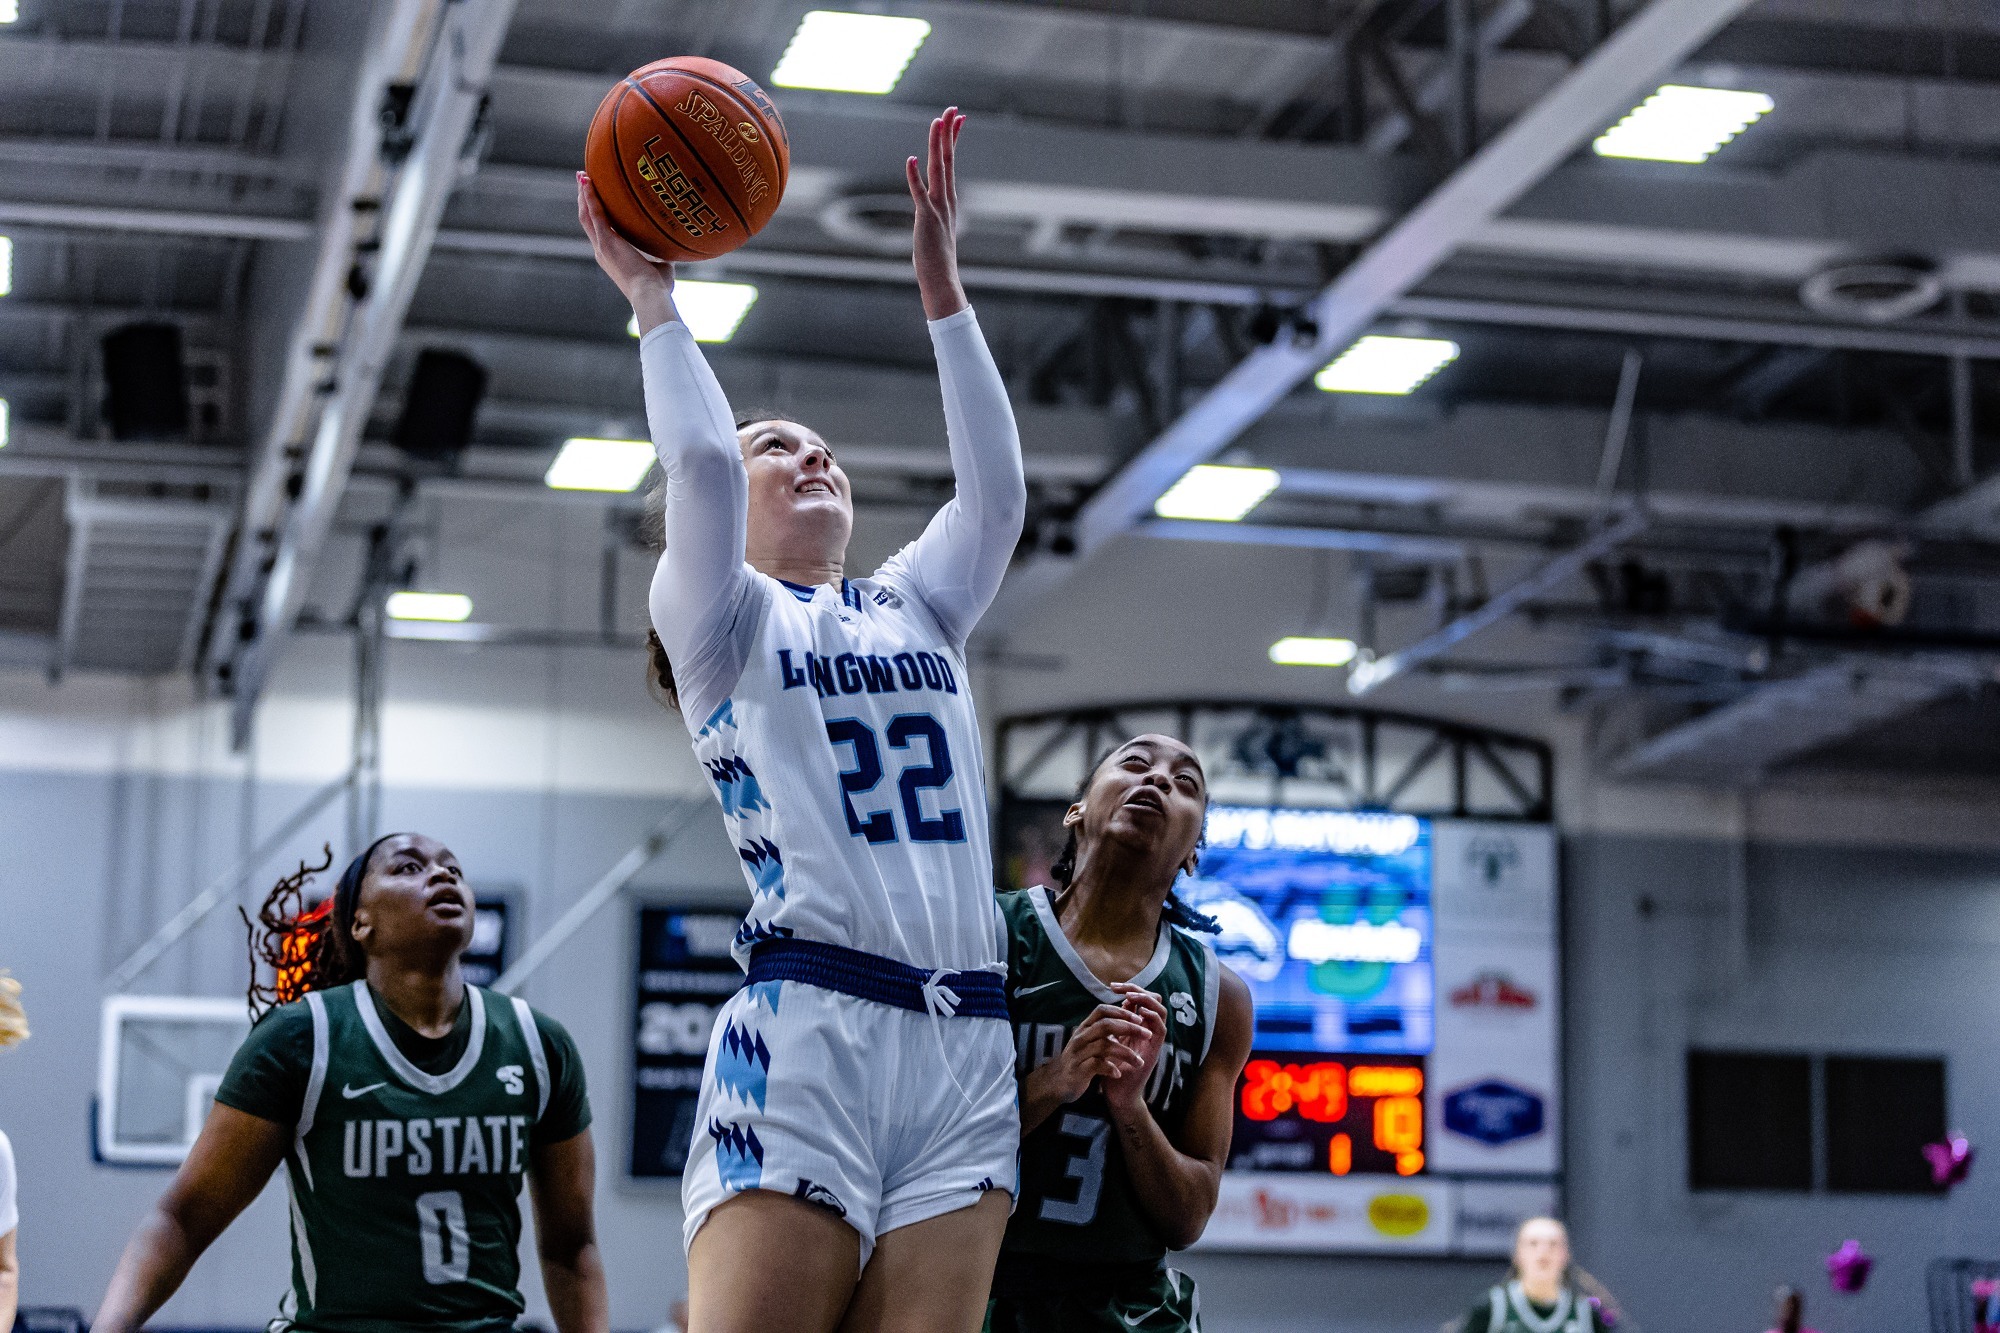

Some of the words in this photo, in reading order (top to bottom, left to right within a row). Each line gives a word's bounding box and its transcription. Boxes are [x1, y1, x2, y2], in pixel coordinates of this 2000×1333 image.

[643, 134, 729, 235] LEGACY
[674, 90, 770, 213] SPALDING
[651, 181, 704, 237] 1000
[825, 712, 967, 845] 22
[343, 1115, 526, 1178] UPSTATE
[1037, 1112, 1111, 1227] 3
[415, 1191, 471, 1285] 0
